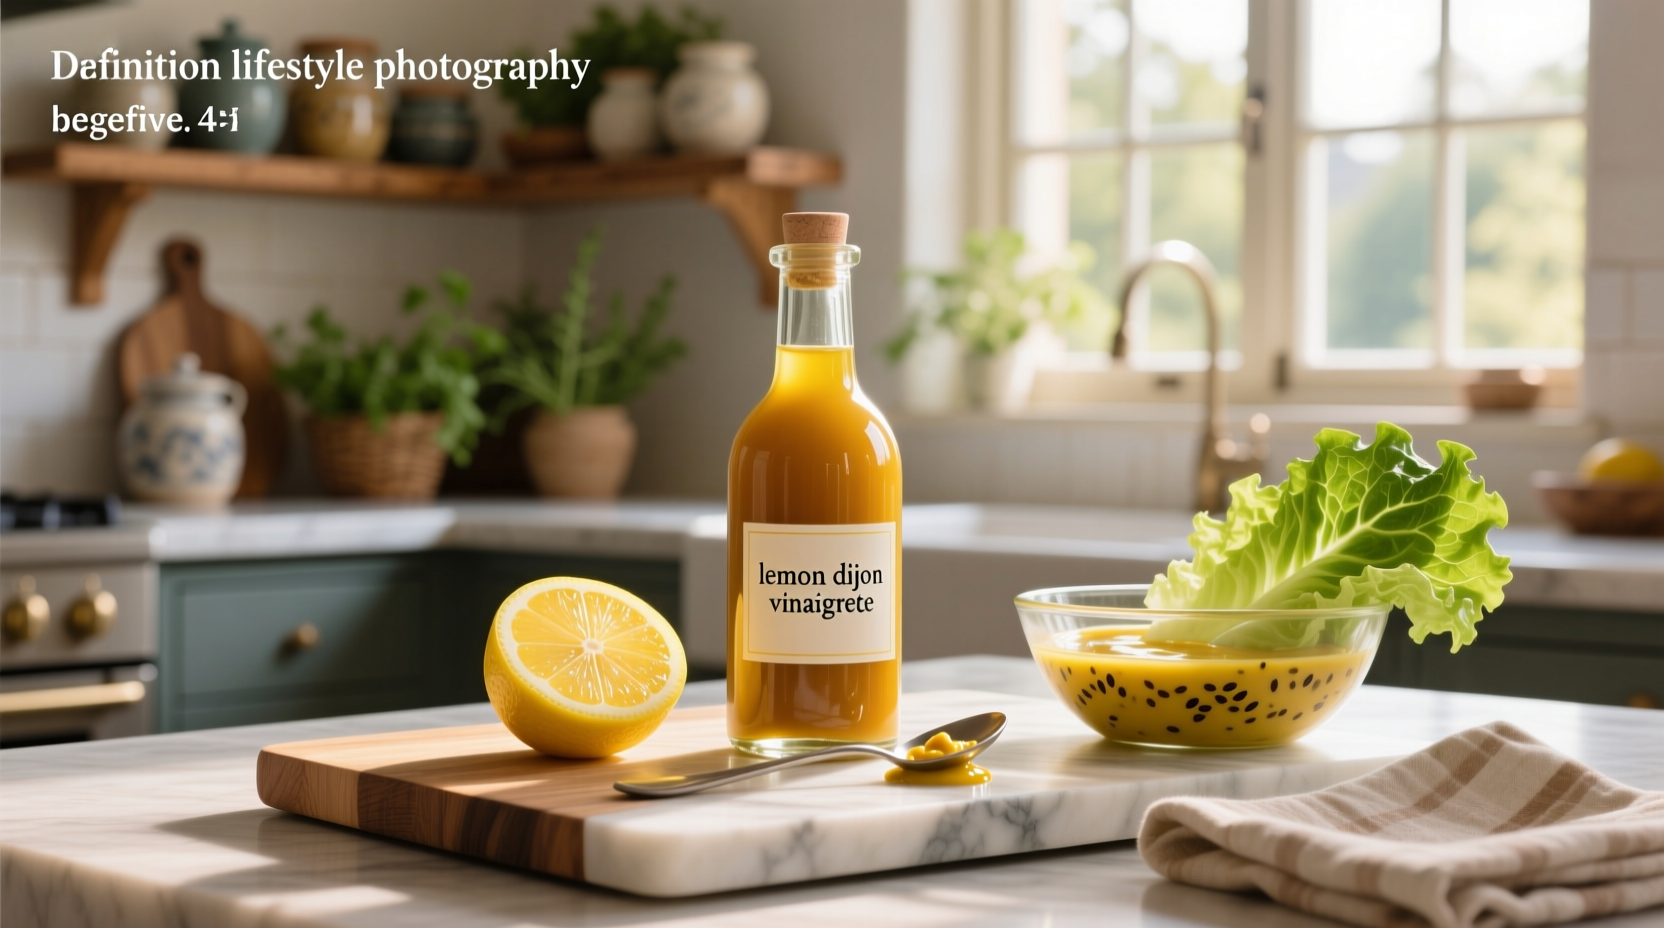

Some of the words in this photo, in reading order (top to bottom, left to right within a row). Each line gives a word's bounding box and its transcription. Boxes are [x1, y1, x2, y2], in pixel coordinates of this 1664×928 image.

[758, 562, 826, 585] lemon
[832, 562, 883, 591] dijon
[769, 592, 874, 620] vinaigrete
